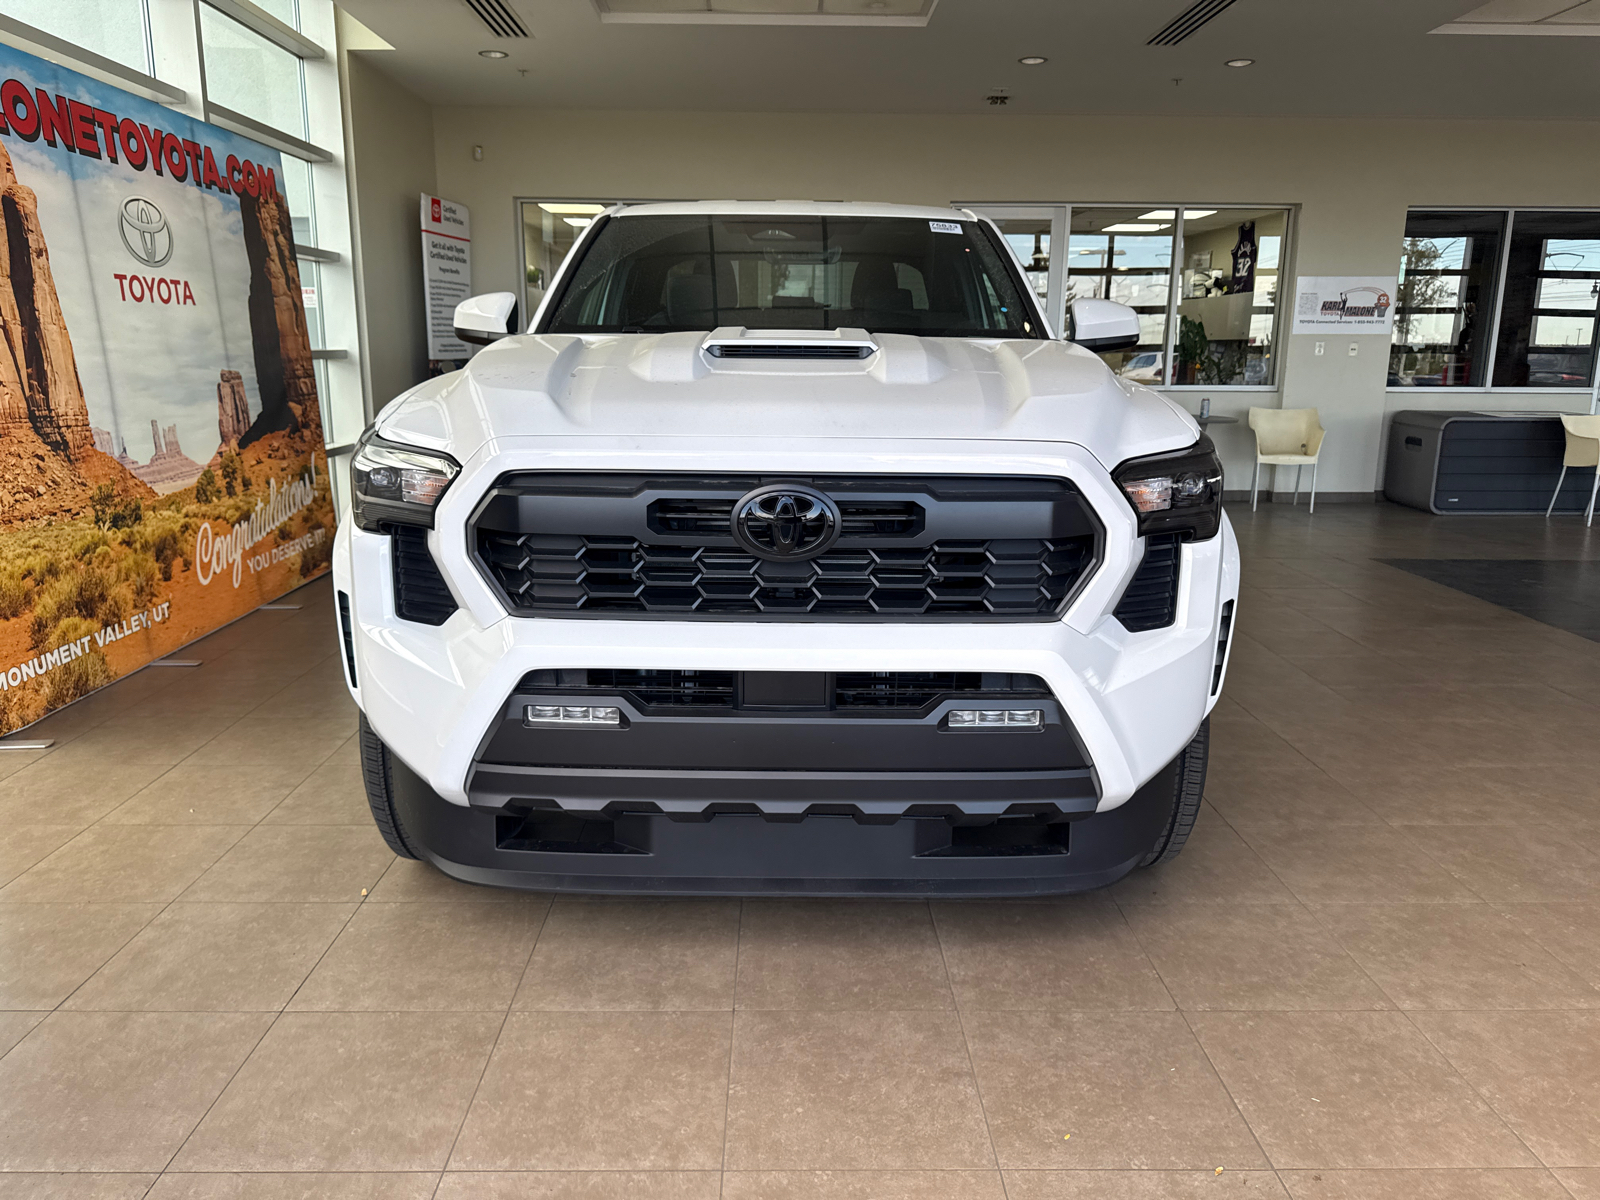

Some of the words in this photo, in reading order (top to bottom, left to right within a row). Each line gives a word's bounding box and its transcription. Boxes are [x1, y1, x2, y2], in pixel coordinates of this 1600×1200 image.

[0, 78, 278, 203] ONETOYOTA.COM
[1235, 257, 1251, 277] 32
[113, 273, 197, 306] TOYOTA
[1321, 301, 1341, 311] KARL
[1344, 306, 1376, 316] MALONE
[196, 451, 318, 588] Congratulations!
[247, 552, 270, 574] YOU
[271, 532, 314, 565] DESERVE
[94, 611, 152, 648] VALLEY,
[152, 602, 169, 622] UT
